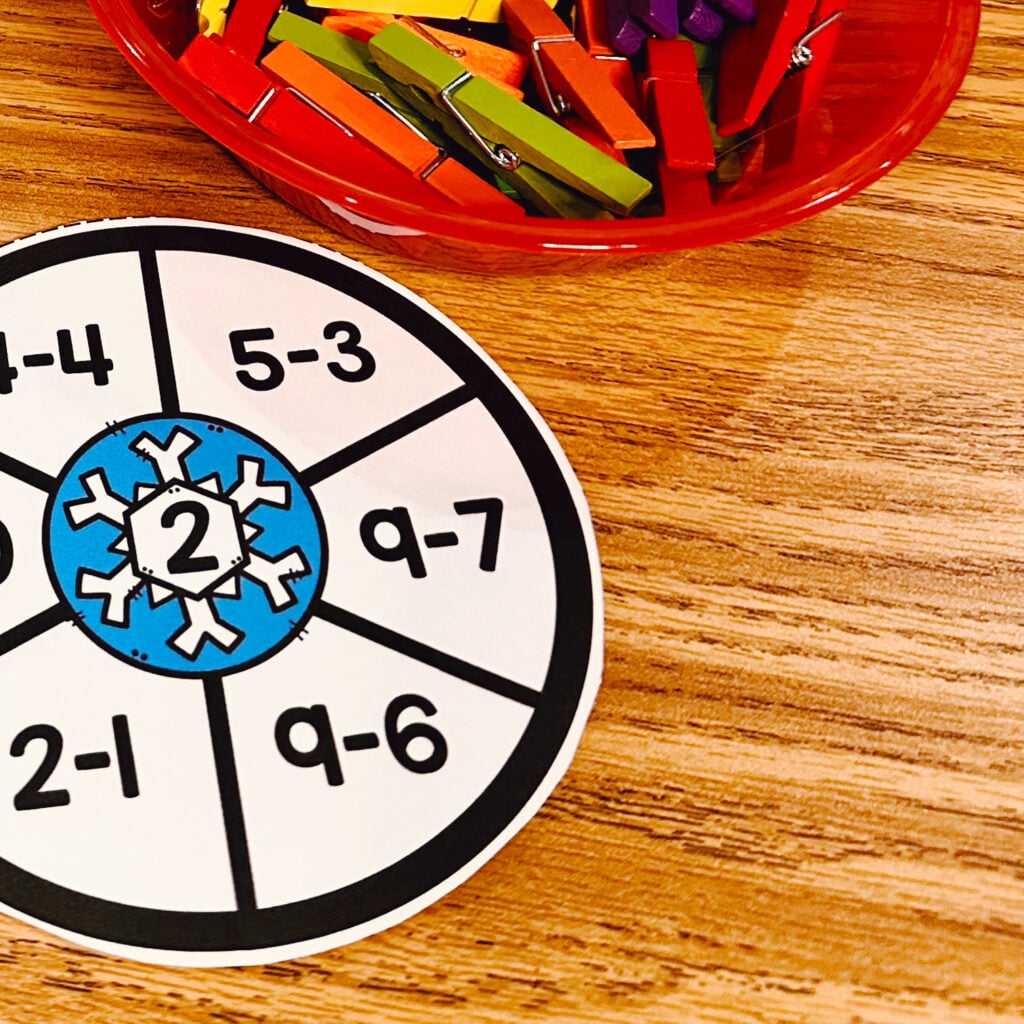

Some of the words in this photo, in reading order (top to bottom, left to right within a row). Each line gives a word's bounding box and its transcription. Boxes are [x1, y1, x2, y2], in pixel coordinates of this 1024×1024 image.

[229, 321, 375, 391] 5-3
[164, 501, 220, 574] 2
[360, 498, 503, 578] 9-7
[10, 715, 139, 811] 2-1
[275, 694, 447, 786] 9-6
